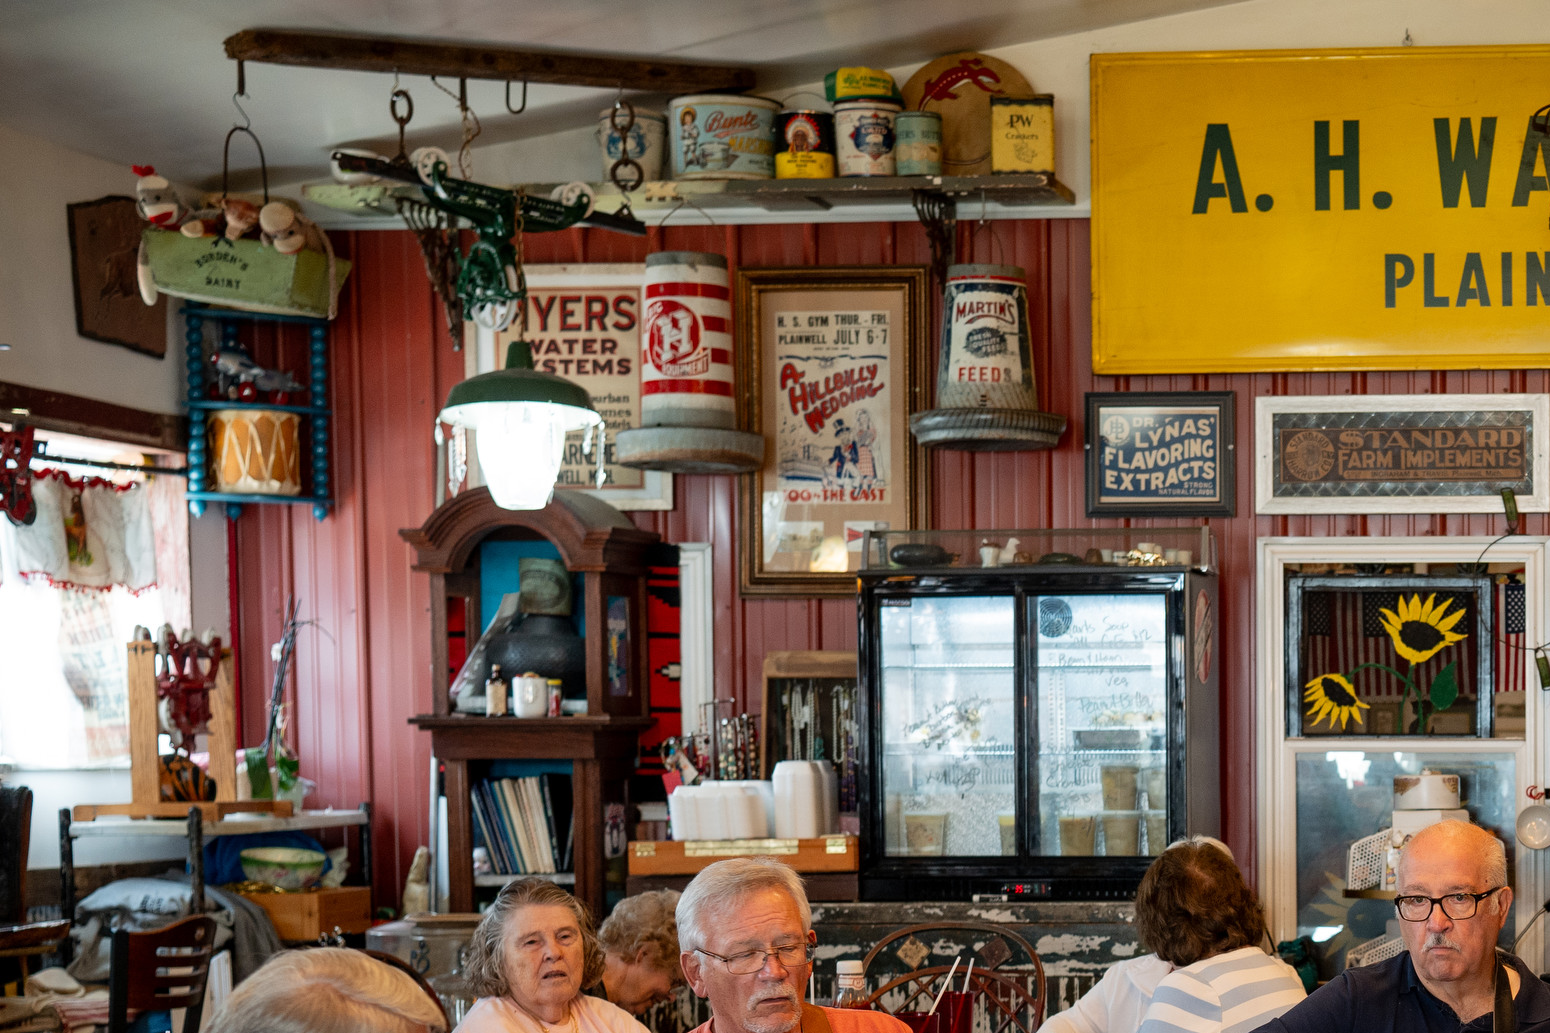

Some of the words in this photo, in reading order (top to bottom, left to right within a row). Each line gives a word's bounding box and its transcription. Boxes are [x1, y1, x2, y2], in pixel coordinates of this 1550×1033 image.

[704, 110, 761, 134] Bunte
[1192, 123, 1275, 215] A.
[1313, 119, 1393, 210] H.
[808, 315, 830, 328] GYM
[835, 313, 862, 327] THUR.
[871, 313, 890, 327] FRI.
[955, 299, 1016, 325] MARTIN'S
[778, 333, 828, 346] PLAINWELL
[833, 328, 861, 346] JULY
[958, 365, 1012, 383] FEEDS
[788, 363, 879, 416] HILLBILLY
[804, 381, 885, 434] WEDDING
[1132, 415, 1159, 429] DR.
[1135, 416, 1216, 449] LYNAS'
[1337, 429, 1522, 450] STANDARD
[1104, 437, 1215, 471] FLAVORING
[1337, 449, 1394, 476] FARM
[1400, 448, 1523, 470] IMPLEMENTS
[1104, 460, 1217, 492] EXTRACTS
[822, 487, 846, 503] THE
[850, 488, 887, 503] CAST
